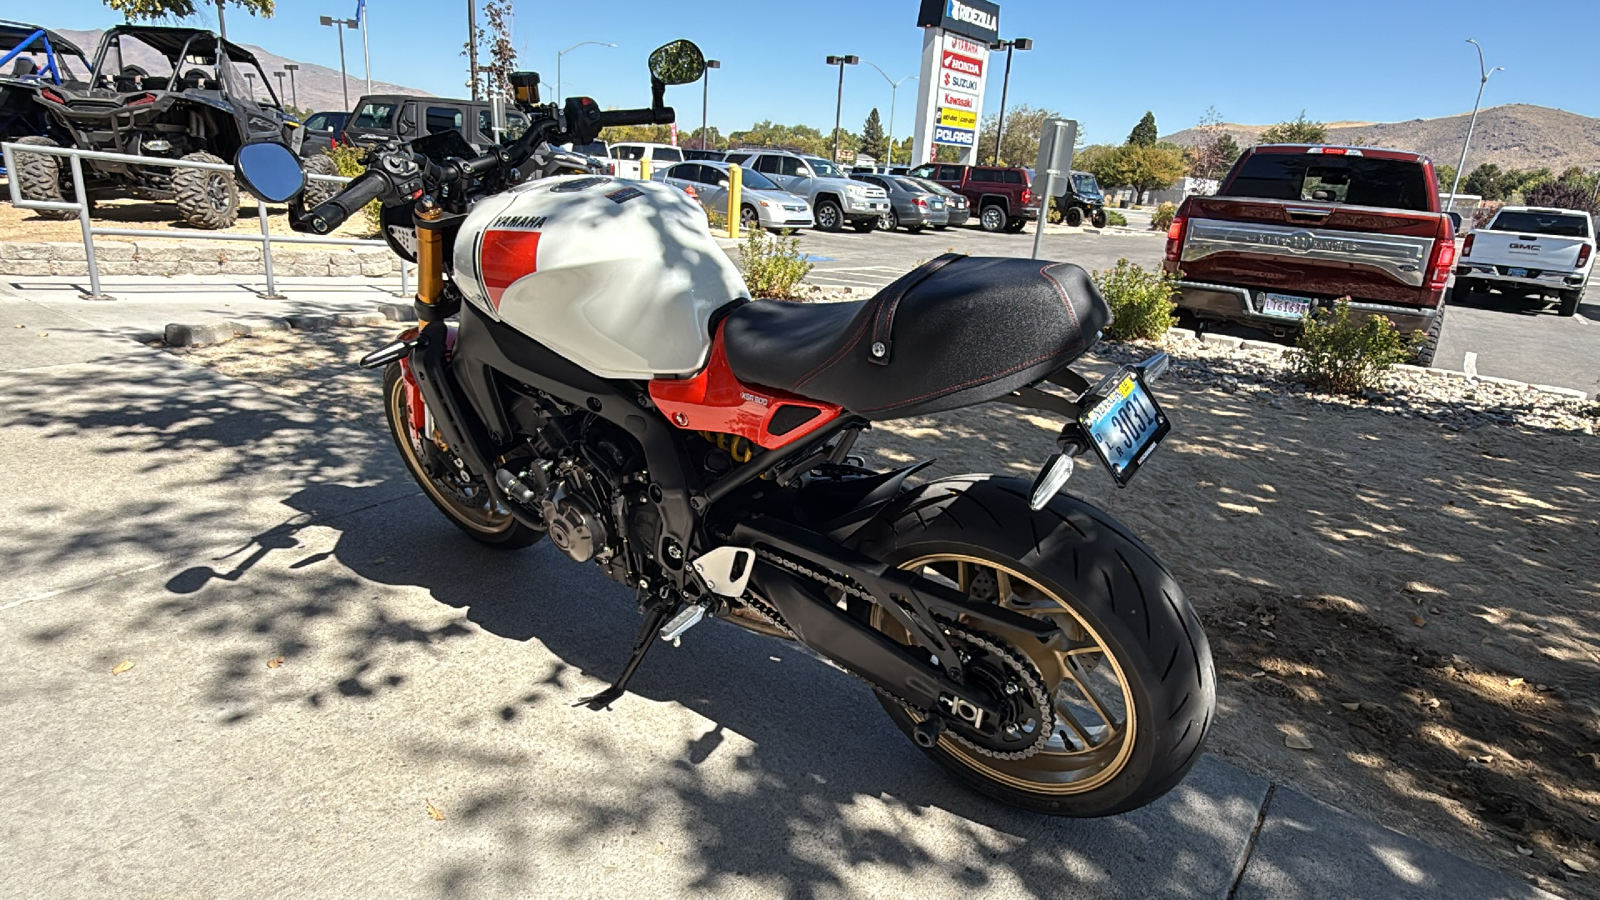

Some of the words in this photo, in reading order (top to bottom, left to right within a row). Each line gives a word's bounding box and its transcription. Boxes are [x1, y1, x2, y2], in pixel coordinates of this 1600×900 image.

[951, 59, 980, 75] HONDA
[952, 76, 977, 90] SUZUKI
[944, 93, 973, 108] Kawasaki
[935, 128, 973, 144] POLARIS
[492, 216, 548, 229] YAMAHA
[1509, 243, 1541, 251] GMC
[1111, 392, 1154, 449] 3031
